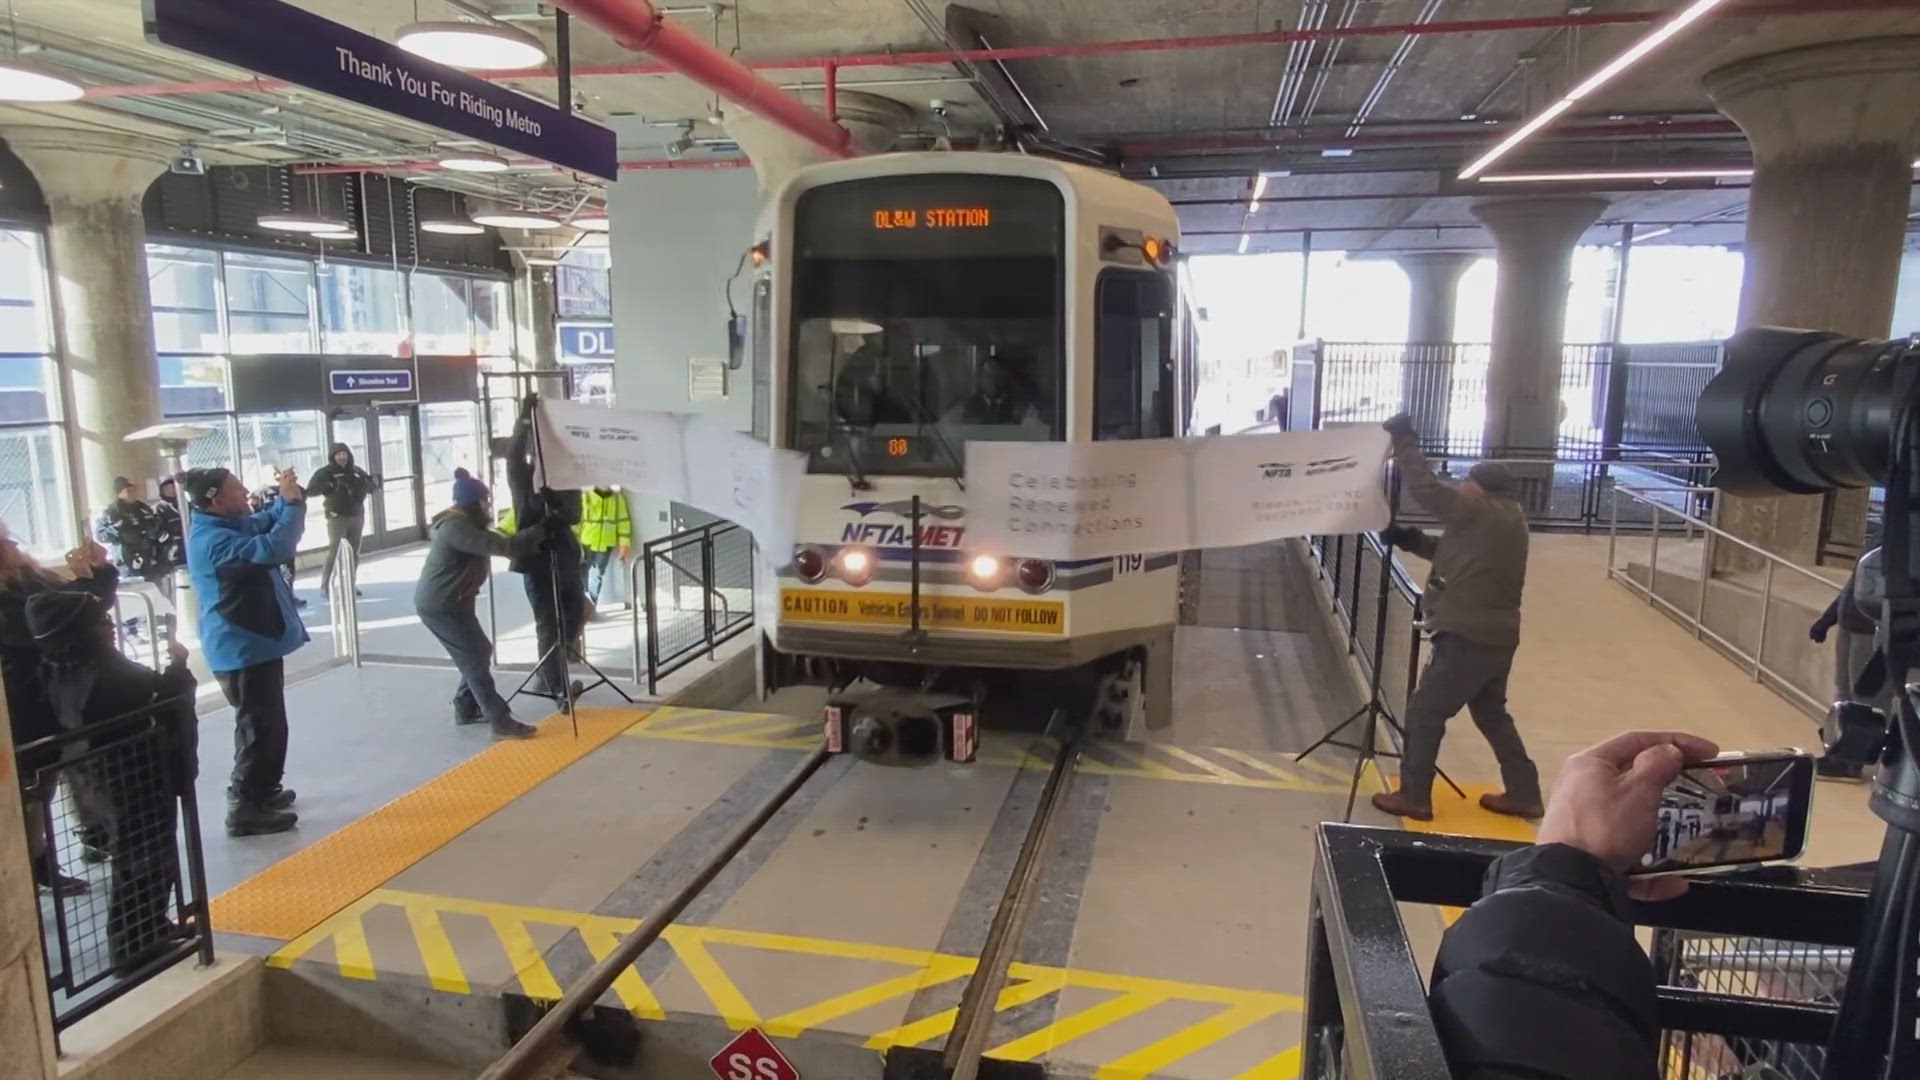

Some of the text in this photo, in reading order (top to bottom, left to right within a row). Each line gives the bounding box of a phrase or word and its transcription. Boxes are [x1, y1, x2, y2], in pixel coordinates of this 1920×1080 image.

[336, 46, 541, 137] Thank You For Riding Metro
[875, 208, 989, 228] DL&W STATION
[783, 595, 848, 614] CAUTION
[974, 605, 988, 622] DO
[991, 606, 1012, 622] NOT
[1016, 607, 1058, 625] FOLLOW
[728, 1052, 779, 1080] SS
